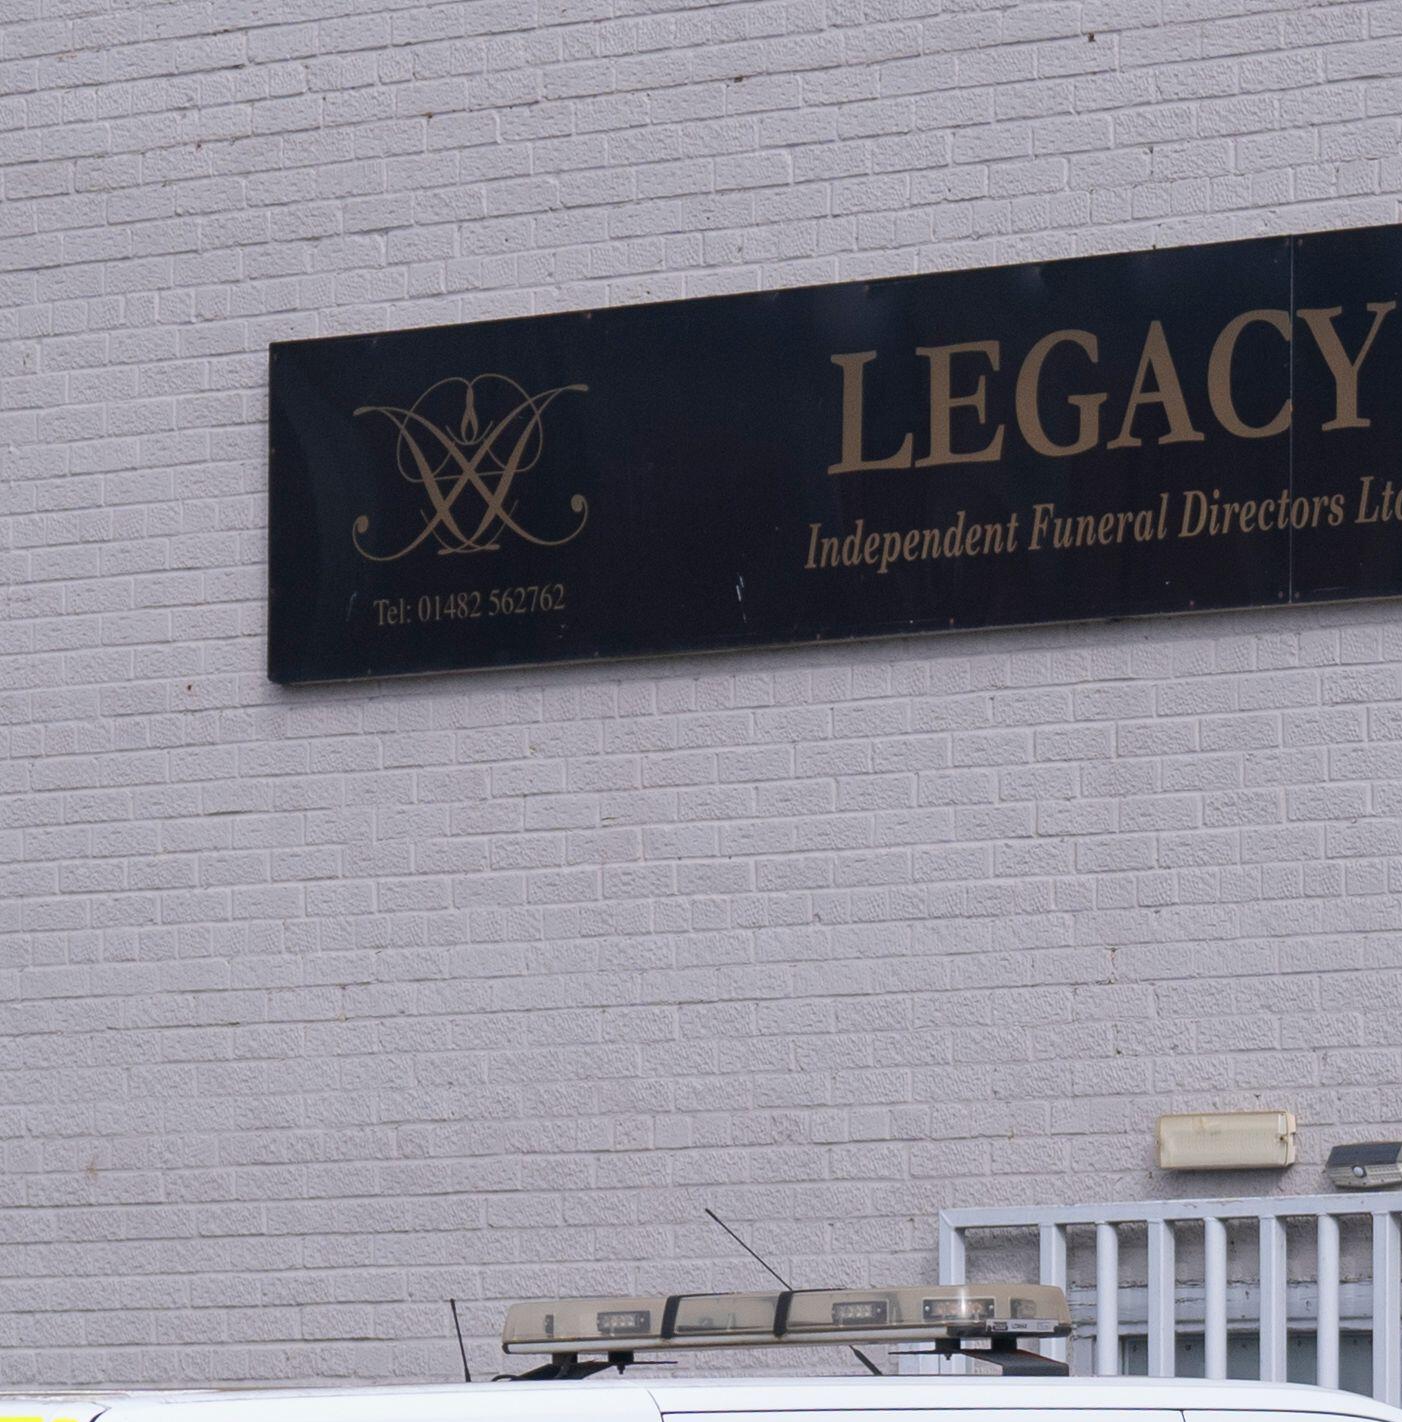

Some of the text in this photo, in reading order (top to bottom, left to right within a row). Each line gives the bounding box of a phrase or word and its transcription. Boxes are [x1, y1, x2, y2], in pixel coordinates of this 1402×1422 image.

[827, 300, 1397, 475] LEGACY
[803, 510, 1020, 573] Independent
[1028, 492, 1169, 550] Funeral
[1178, 483, 1345, 538] Directors
[373, 583, 567, 625] Tel: 01482 562762
